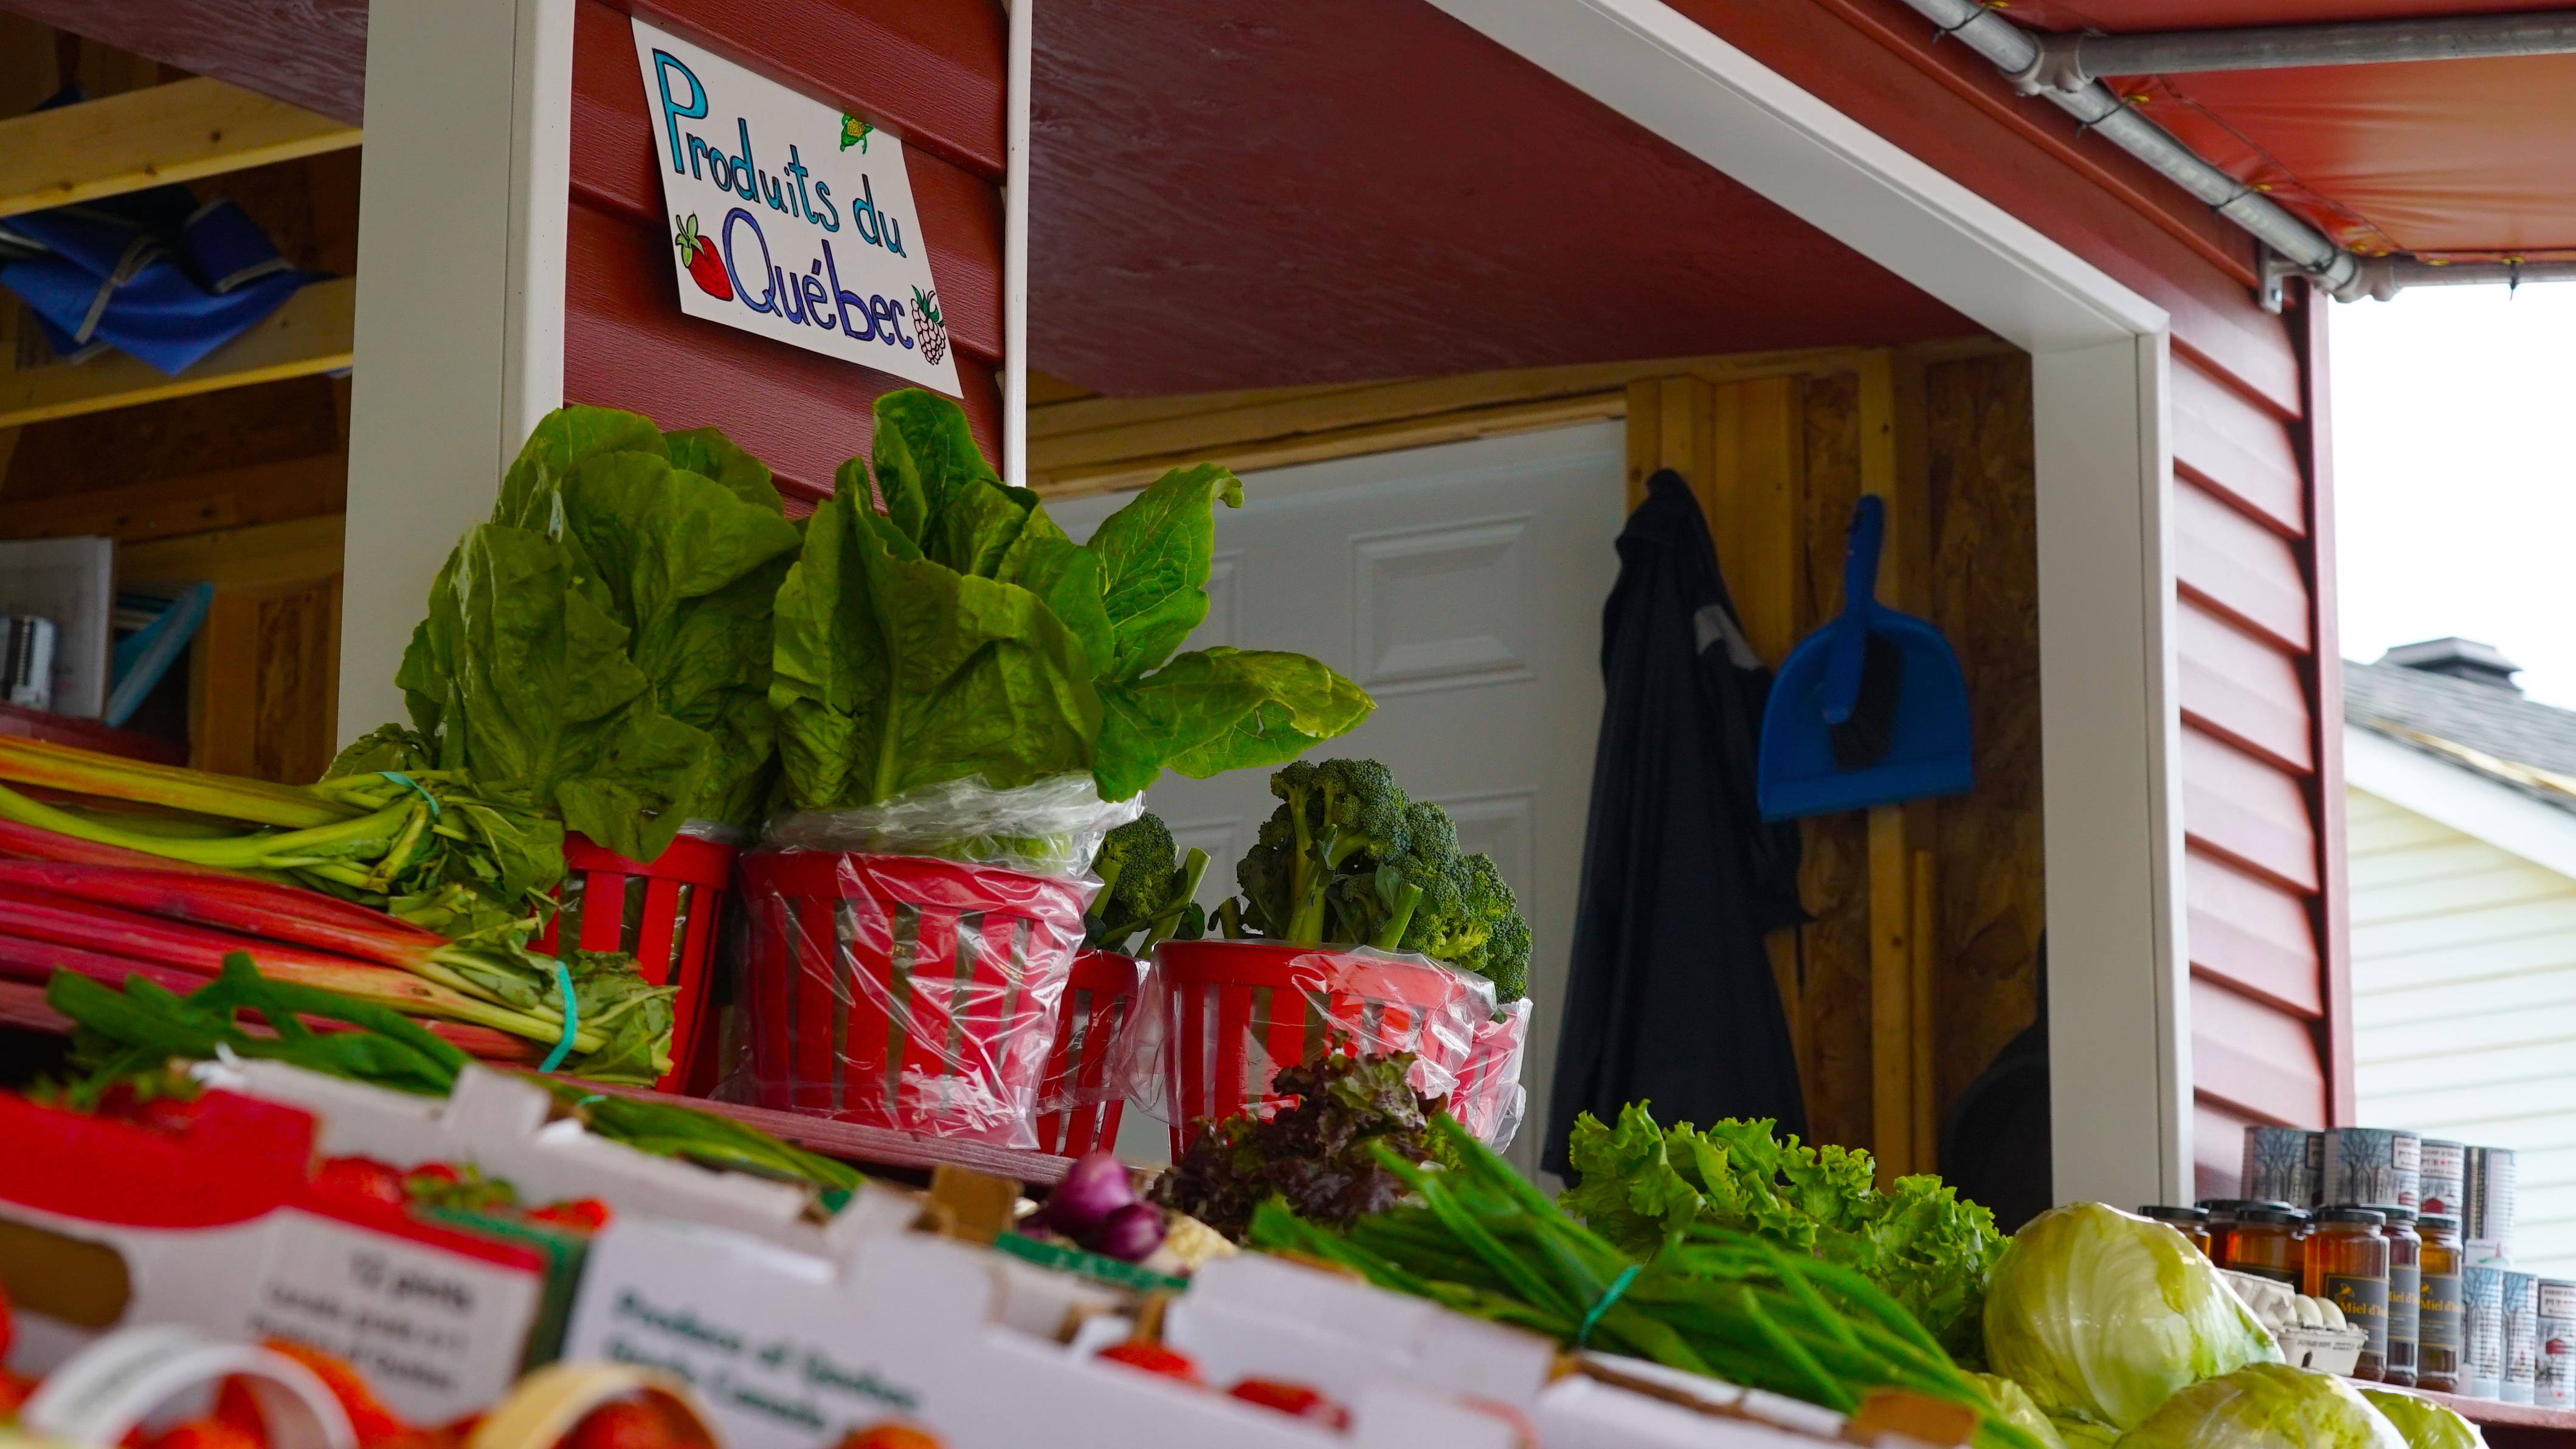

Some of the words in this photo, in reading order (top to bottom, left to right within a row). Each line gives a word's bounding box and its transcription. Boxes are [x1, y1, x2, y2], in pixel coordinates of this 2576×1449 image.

[651, 47, 840, 233] Produits
[852, 174, 906, 258] du
[722, 207, 914, 350] Québec
